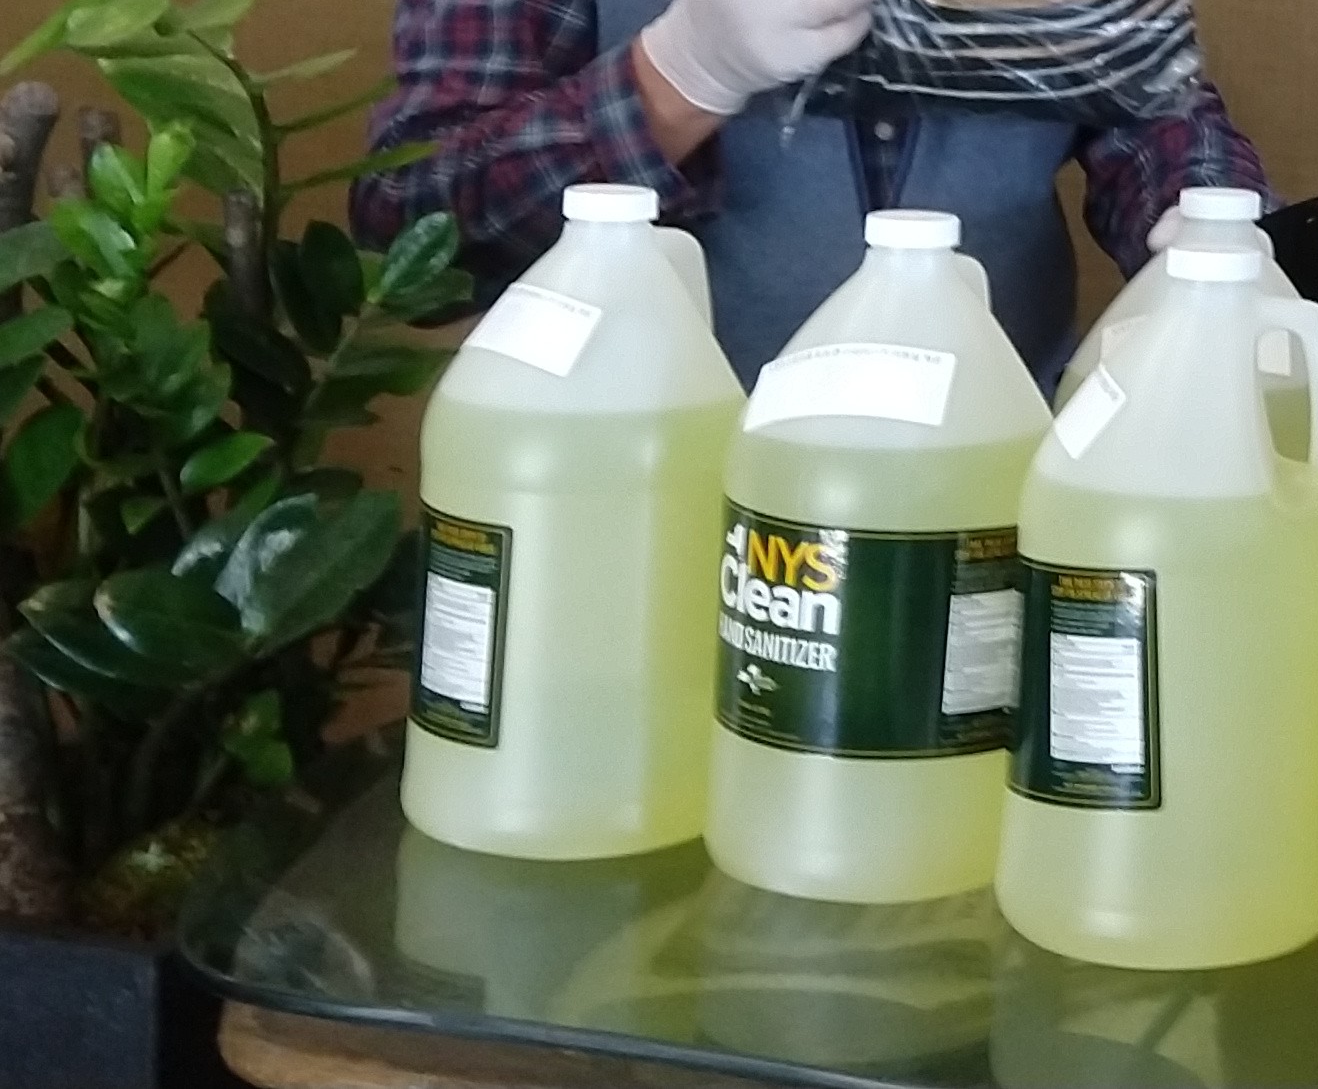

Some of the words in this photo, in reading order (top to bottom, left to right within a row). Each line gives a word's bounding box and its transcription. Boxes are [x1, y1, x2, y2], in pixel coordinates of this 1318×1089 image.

[747, 528, 837, 592] NYS
[720, 553, 841, 636] Clean
[744, 625, 837, 673] SANITIZER
